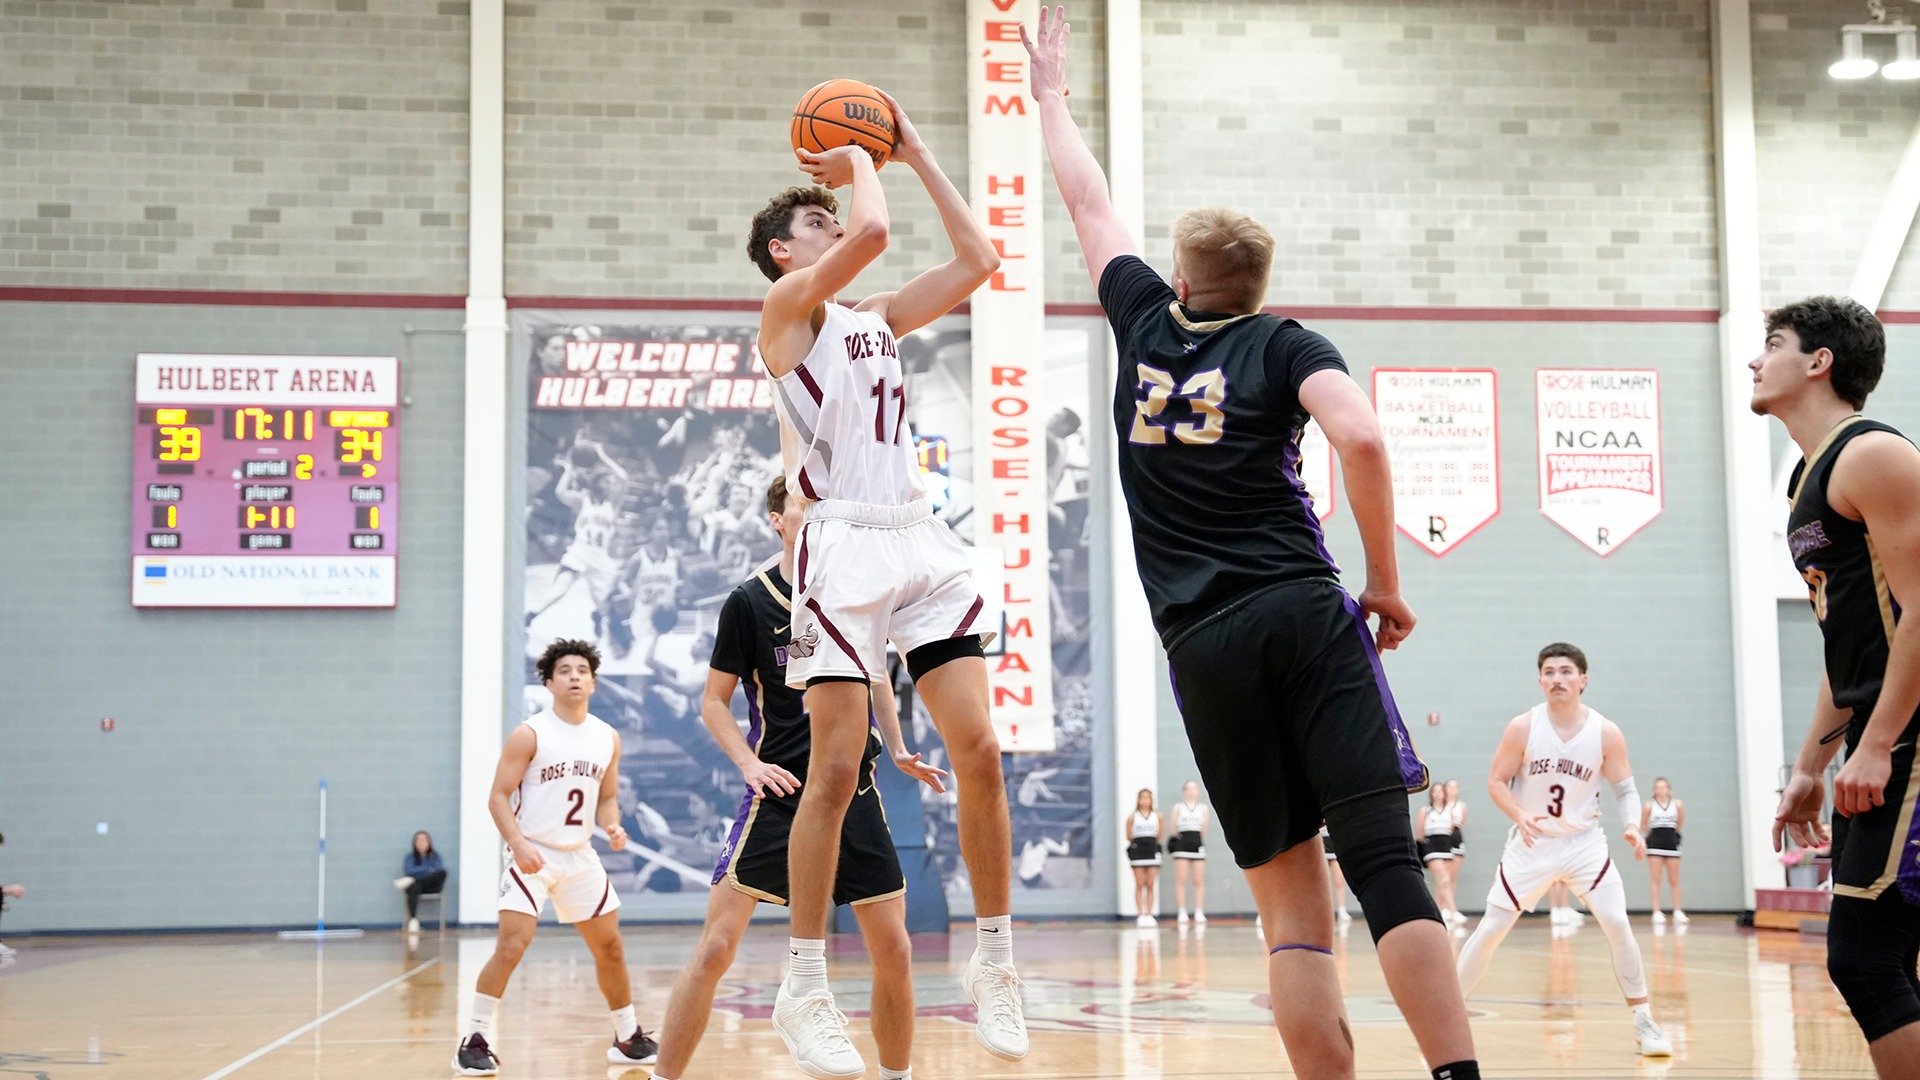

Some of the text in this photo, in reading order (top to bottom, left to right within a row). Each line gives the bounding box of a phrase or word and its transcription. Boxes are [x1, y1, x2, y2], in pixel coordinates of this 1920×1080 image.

[988, 175, 1025, 291] HELL
[565, 341, 740, 372] WELCOME
[157, 367, 376, 392] HULBERT ARENA
[537, 377, 774, 408] HULBERT ARE
[1128, 362, 1228, 445] 23
[1384, 400, 1484, 413] BASKETBALL
[1544, 400, 1652, 420] VOLLEYBALL
[235, 408, 314, 440] 17:11
[1418, 414, 1454, 425] NCAA
[159, 427, 201, 461] 39
[341, 429, 382, 463] 34
[1555, 430, 1643, 449] NCAA
[246, 460, 288, 478] period
[295, 454, 314, 480] 2
[1549, 455, 1651, 470] TOURNAMENT
[149, 484, 181, 500] fouls
[1550, 471, 1651, 492] APPEARANCES
[245, 485, 289, 502] player
[351, 486, 383, 501] fouls
[167, 505, 177, 529] 1
[369, 506, 379, 529] 1
[151, 535, 178, 548] won
[249, 534, 283, 550] game
[353, 535, 380, 548] won
[173, 564, 380, 580] OLD NATIONAL BANK
[564, 788, 584, 827] 2
[1547, 784, 1565, 818] 3
